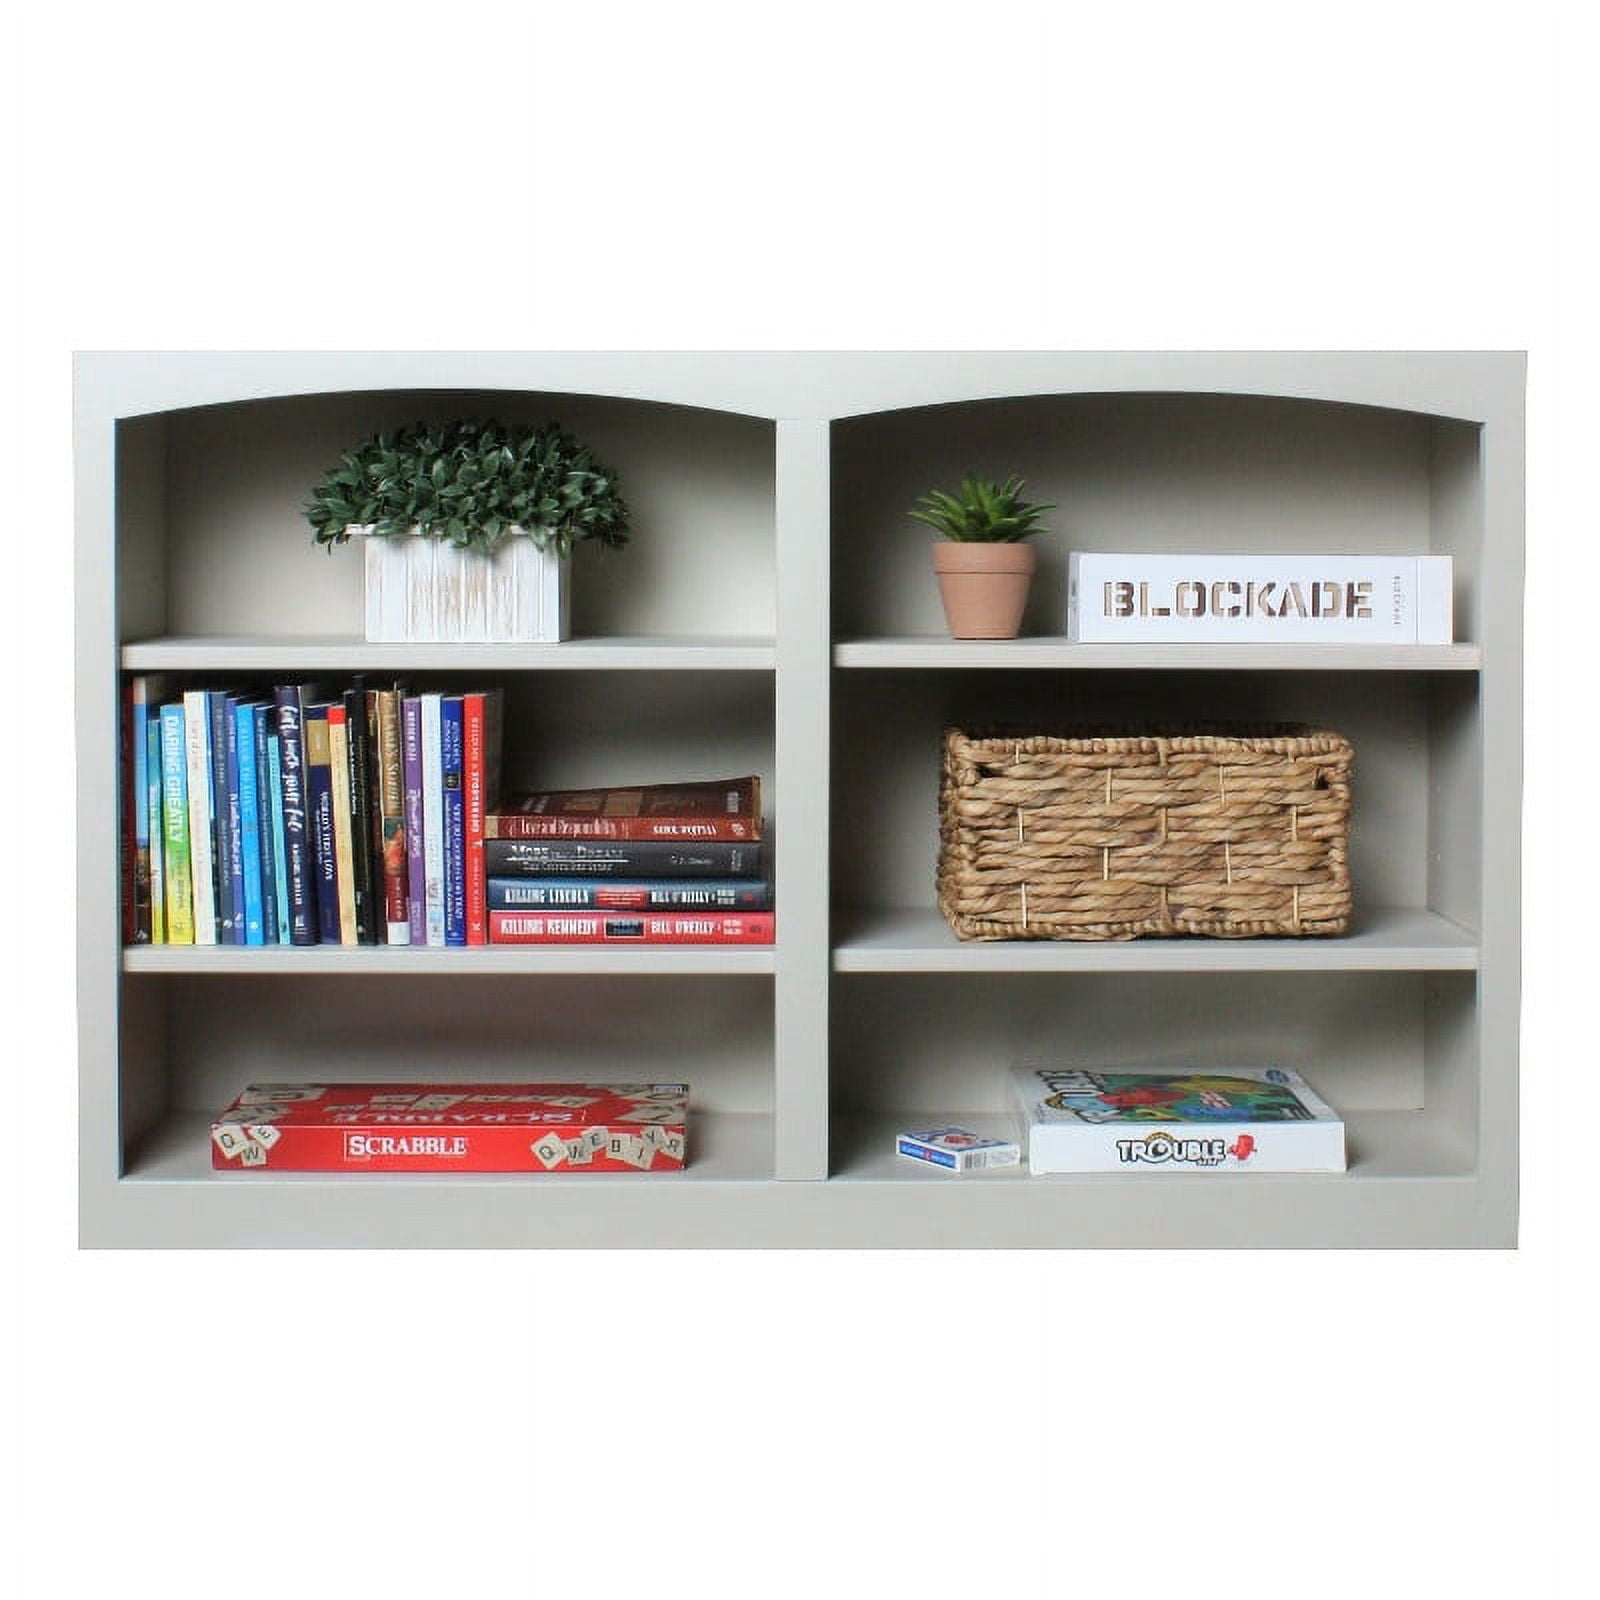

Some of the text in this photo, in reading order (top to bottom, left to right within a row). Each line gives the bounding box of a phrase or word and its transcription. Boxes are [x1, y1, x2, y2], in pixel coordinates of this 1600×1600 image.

[1103, 581, 1373, 618] BLOCKADE
[163, 716, 181, 772] DARING
[167, 775, 185, 843] GREATLY
[504, 888, 545, 904] KILLING
[549, 888, 589, 904] LINCOLN
[501, 918, 597, 935] KILLING KENNEDY
[651, 919, 672, 934] BILL
[349, 1134, 467, 1156] SCRABBLE
[1116, 1138, 1227, 1164] TROUBLE
